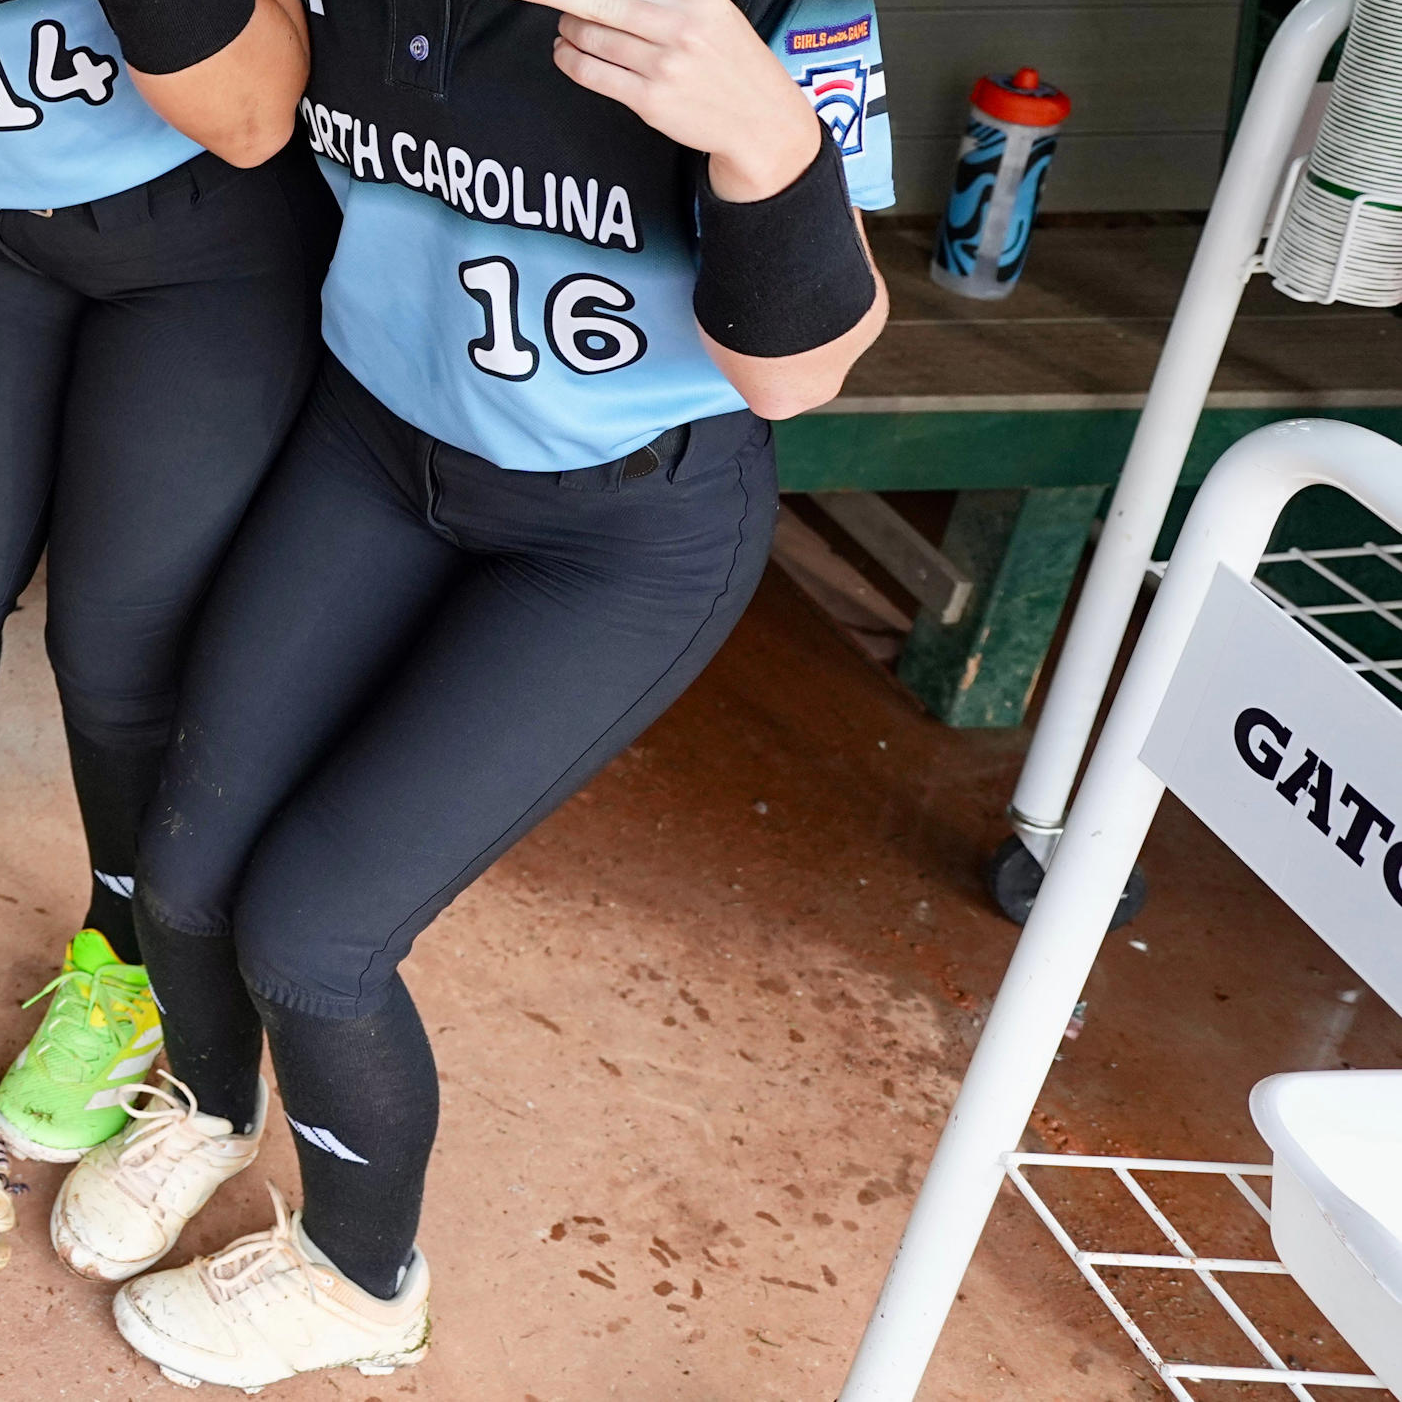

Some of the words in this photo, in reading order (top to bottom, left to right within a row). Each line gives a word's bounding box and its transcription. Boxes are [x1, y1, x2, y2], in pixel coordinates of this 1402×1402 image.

[793, 31, 828, 50] GIRLS
[847, 20, 869, 41] GAME
[298, 96, 384, 180] ORTH
[392, 131, 637, 249] CAROLINA
[458, 255, 648, 383] 16
